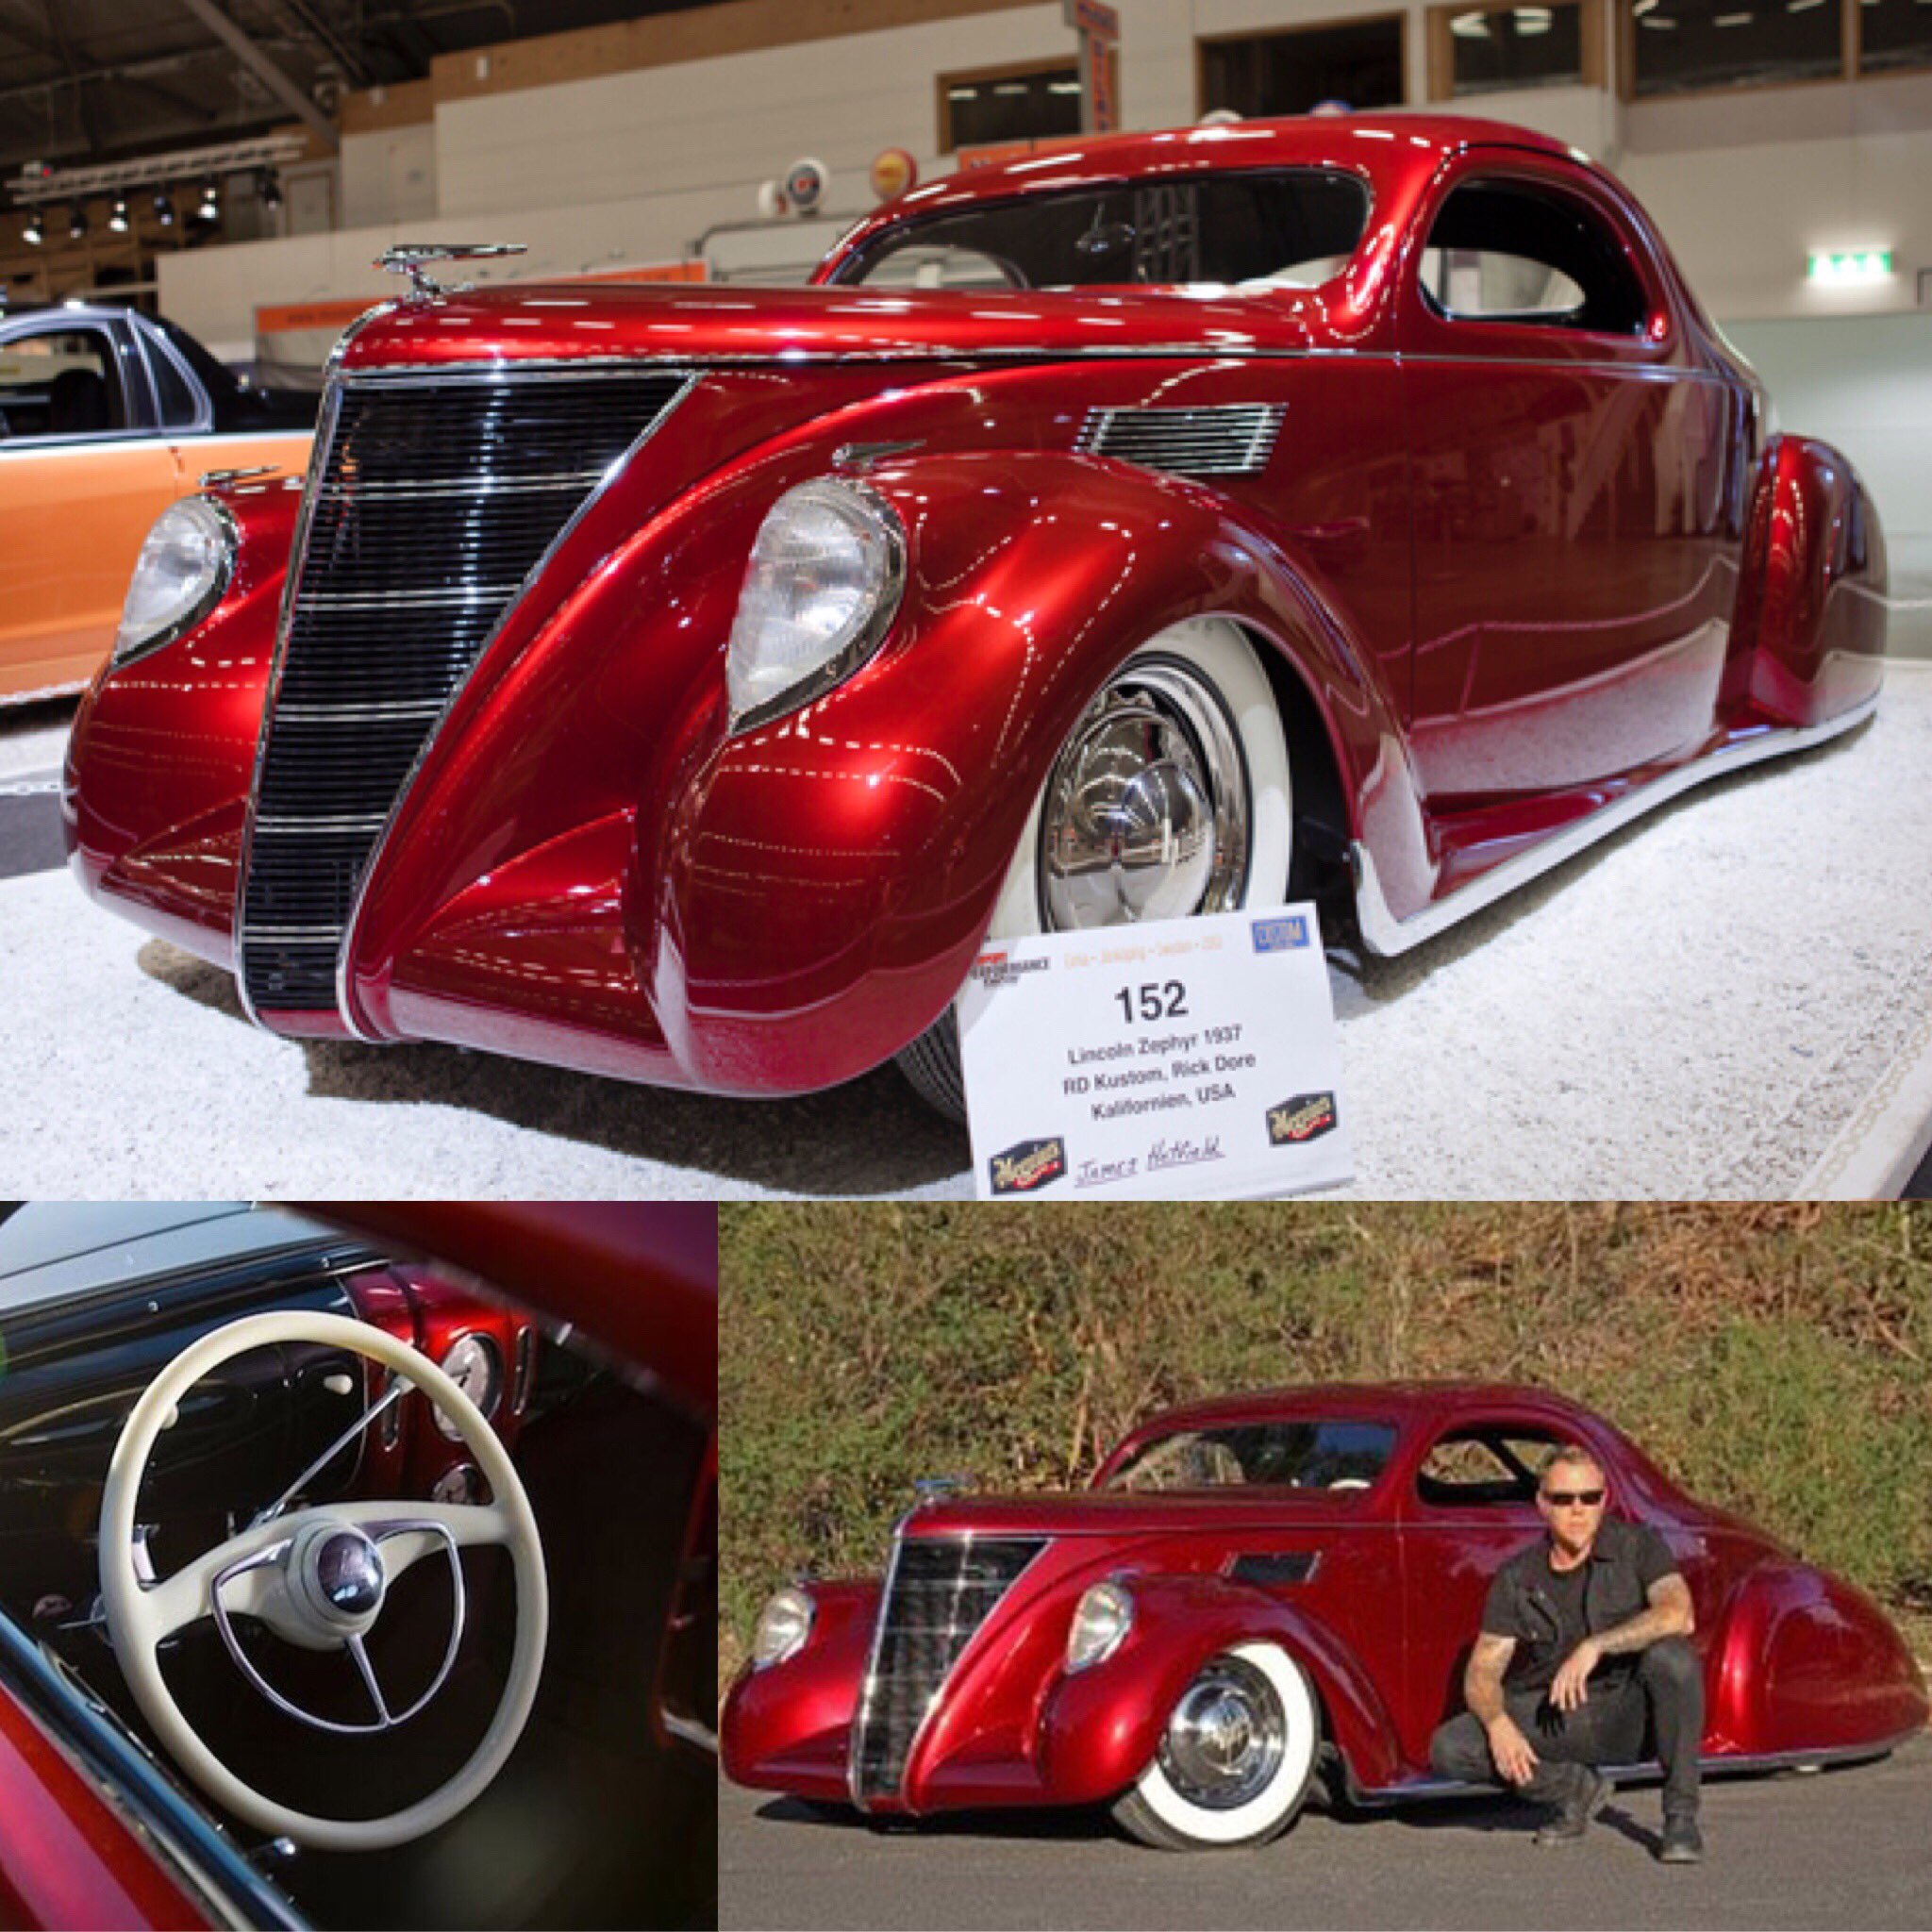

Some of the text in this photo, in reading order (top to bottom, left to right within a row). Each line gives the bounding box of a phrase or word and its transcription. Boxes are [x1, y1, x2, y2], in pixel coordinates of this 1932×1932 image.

[1115, 979, 1189, 1024] 152
[1068, 1024, 1241, 1064] Lincoln Zephyr 1937
[1063, 1053, 1256, 1094] RD Kustom, Rick Dore
[1091, 1083, 1236, 1121] Kalifornien, USA
